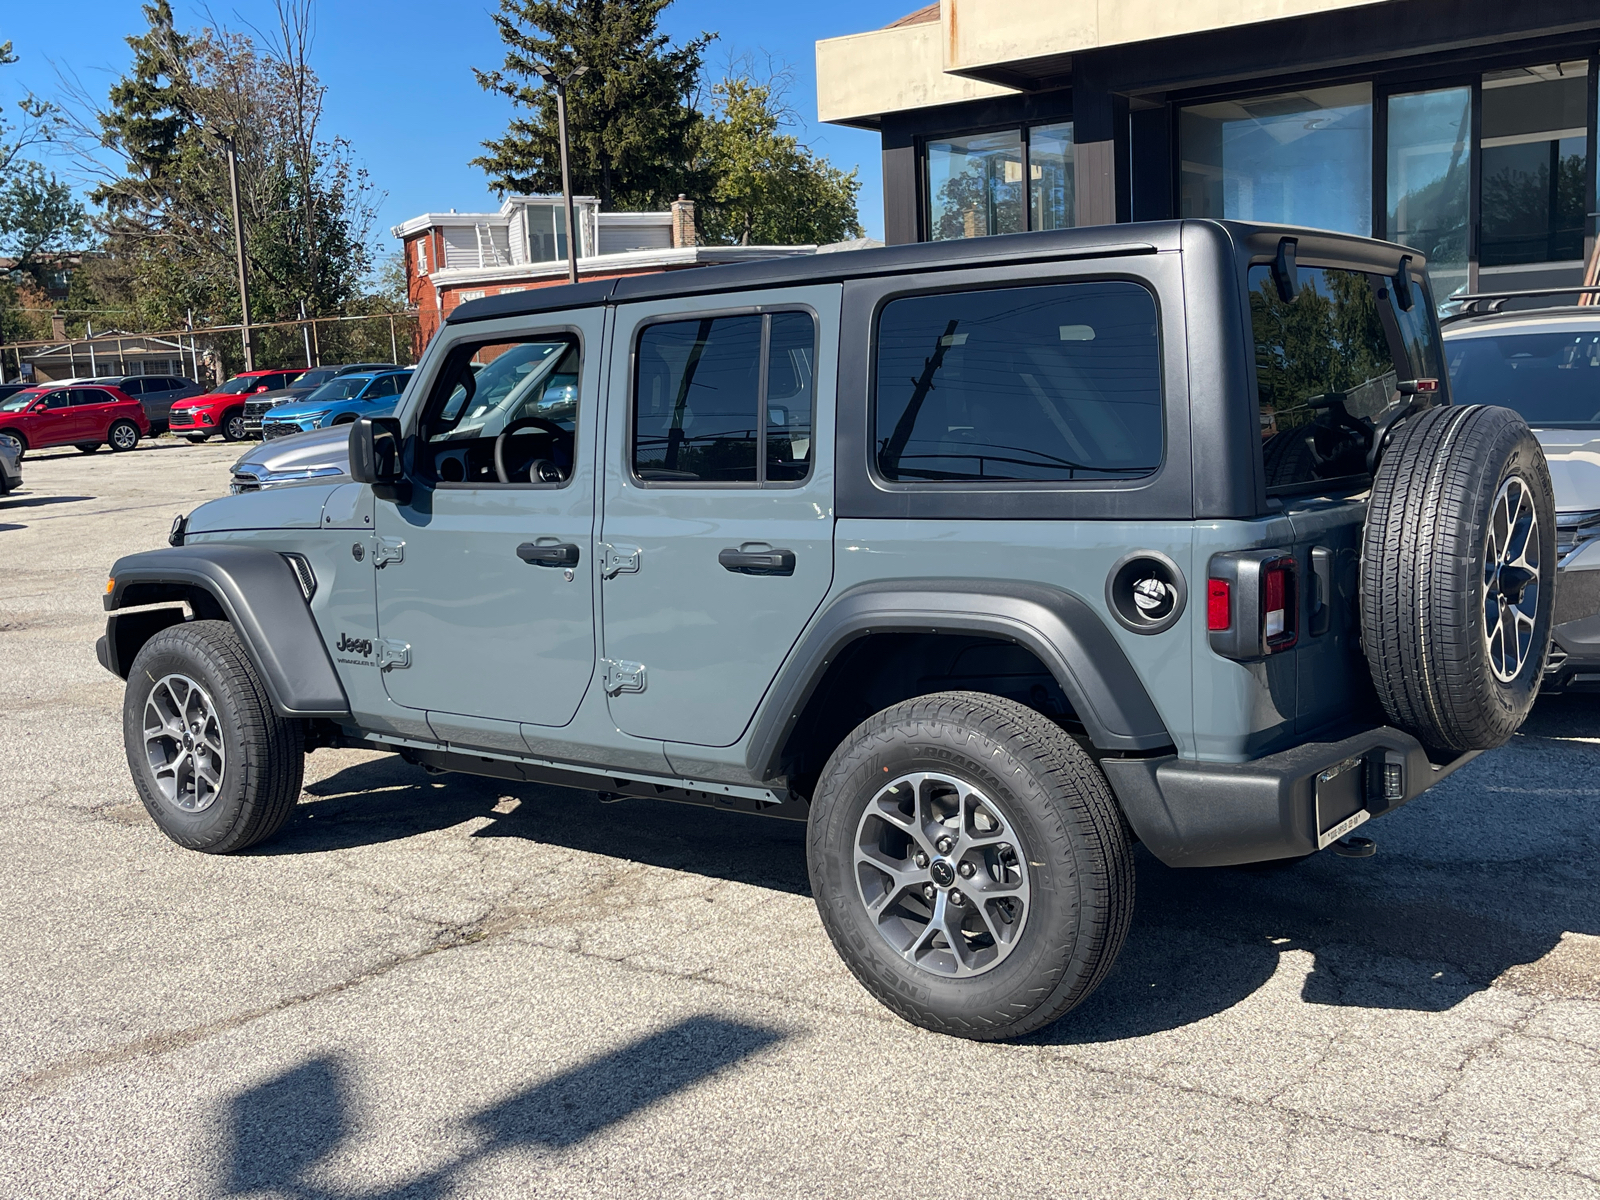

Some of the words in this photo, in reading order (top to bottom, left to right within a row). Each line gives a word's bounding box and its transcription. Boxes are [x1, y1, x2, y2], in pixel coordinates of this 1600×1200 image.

[336, 632, 373, 658] Jeep
[336, 657, 369, 667] WRANGLER
[923, 746, 1015, 801] ROADIAN
[839, 911, 919, 998] NEXEN
